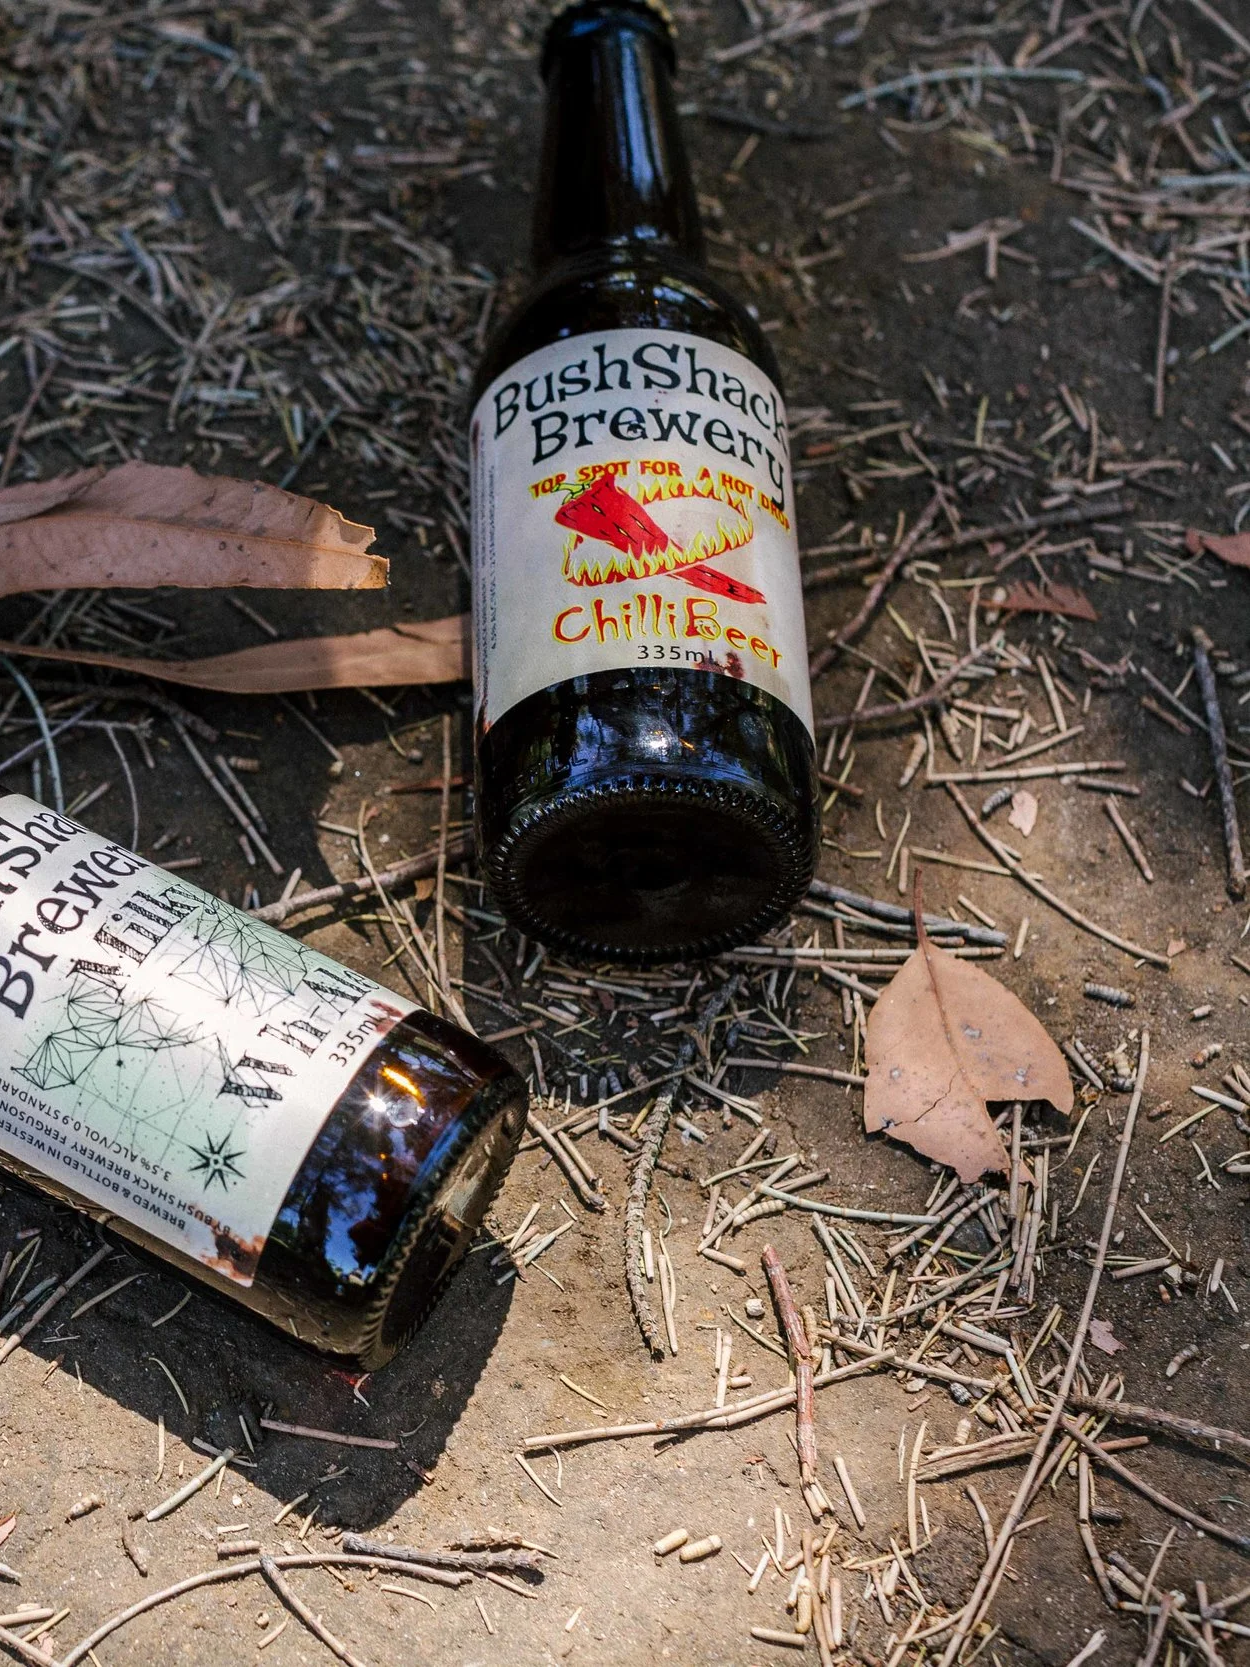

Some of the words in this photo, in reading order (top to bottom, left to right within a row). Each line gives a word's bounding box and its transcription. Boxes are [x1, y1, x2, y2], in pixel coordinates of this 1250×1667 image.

[531, 406, 785, 512] Brewery
[530, 473, 567, 499] TOP
[577, 461, 630, 482] SPOT
[639, 460, 682, 478] FOR
[698, 467, 711, 481] A
[719, 471, 755, 499] HOT
[66, 884, 217, 1003] Milky
[60, 1113, 82, 1131] 0.9
[45, 1145, 61, 1159] IN
[70, 1139, 132, 1179] BREWERY
[80, 1124, 138, 1162] ALC/VOL
[60, 1153, 120, 1193] BOTTLED
[137, 1156, 171, 1180] 3.5%
[119, 1186, 131, 1199] &
[130, 1173, 176, 1204] SHACK
[130, 1192, 187, 1229] BREWED
[175, 1198, 214, 1226] BUSH
[214, 1220, 231, 1235] BY
